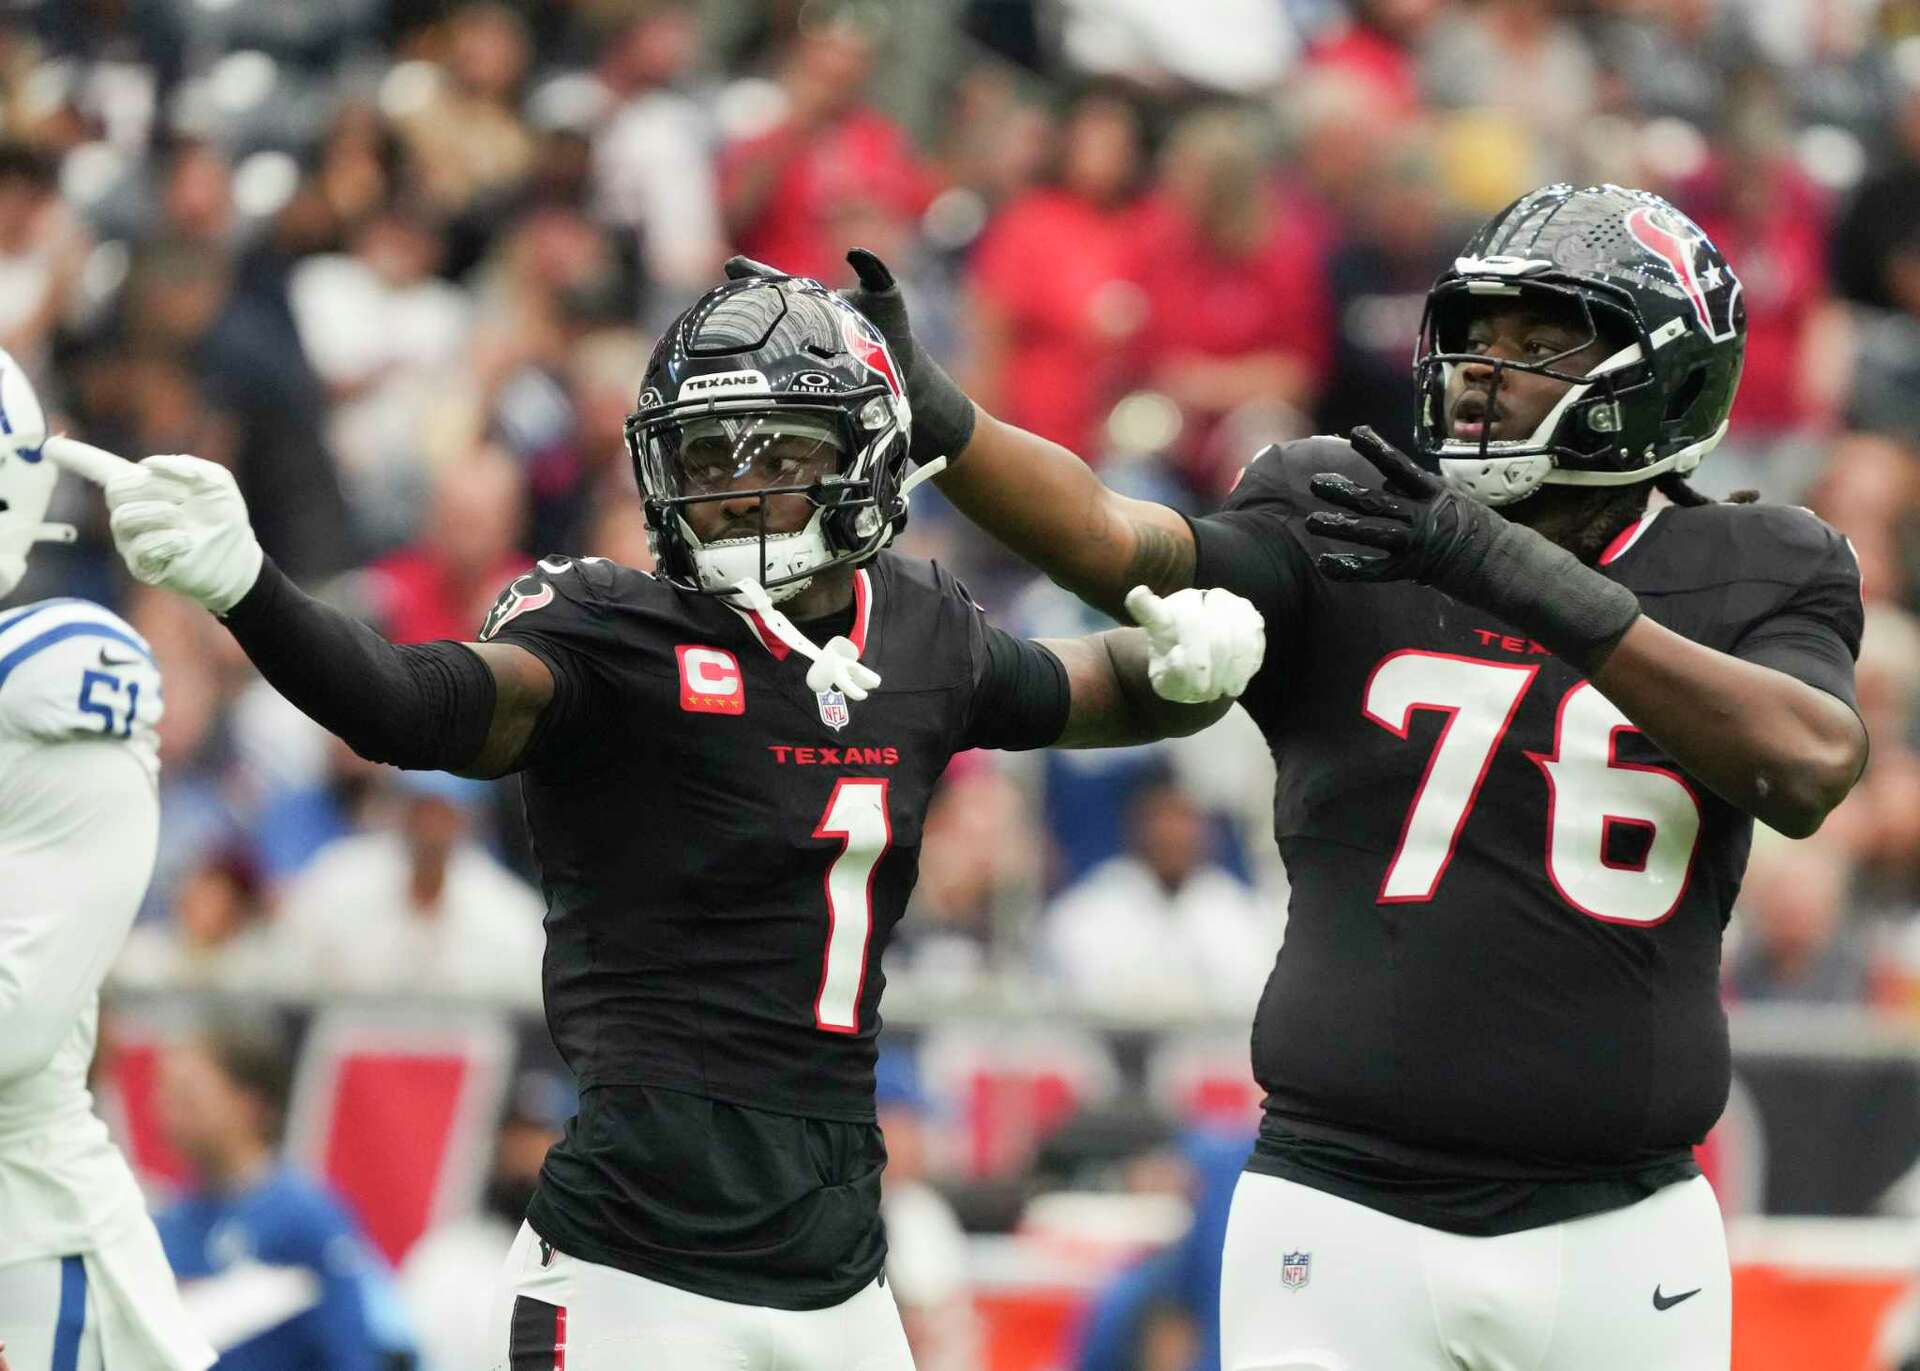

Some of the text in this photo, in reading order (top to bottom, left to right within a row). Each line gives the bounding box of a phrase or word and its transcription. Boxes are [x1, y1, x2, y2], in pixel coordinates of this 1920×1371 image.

[686, 375, 759, 391] TEXANS
[1472, 628, 1552, 656] TEX
[684, 648, 738, 696] C
[78, 670, 138, 738] 51
[824, 705, 846, 722] NFL
[768, 745, 900, 766] TEXANS
[1362, 648, 1701, 929] 76
[811, 777, 894, 1034] 1
[1285, 1266, 1305, 1283] NFL
